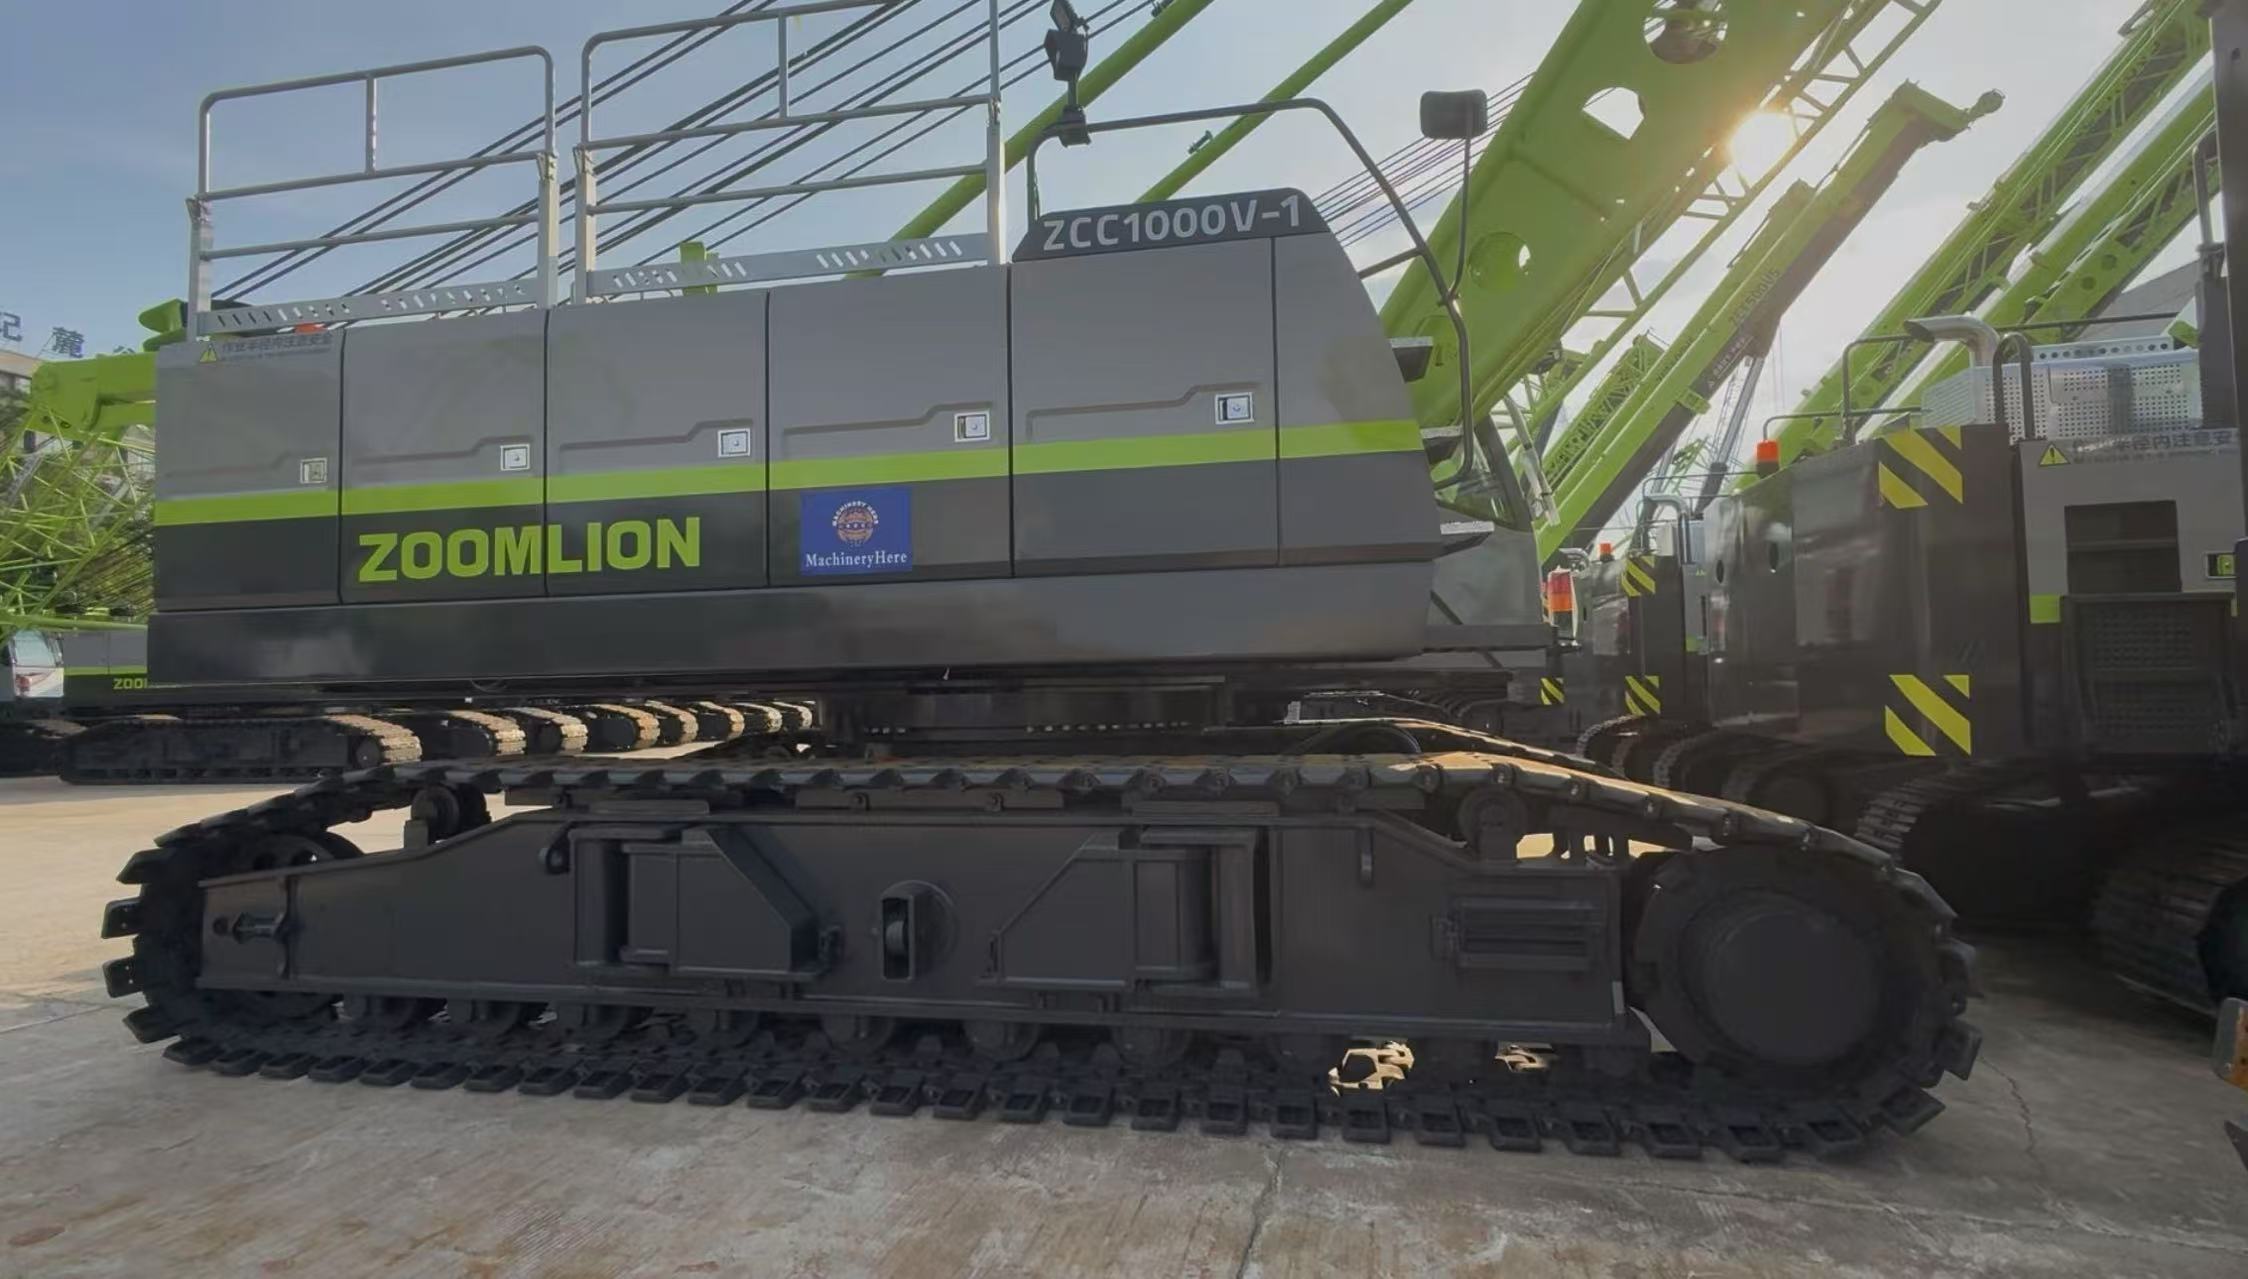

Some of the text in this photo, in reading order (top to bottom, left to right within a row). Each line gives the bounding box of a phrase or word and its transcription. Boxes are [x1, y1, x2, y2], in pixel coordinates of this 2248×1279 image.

[1043, 194, 1300, 251] ZCC1000V-1
[358, 516, 701, 582] ZOOMLION
[805, 550, 908, 569] MachineryHere
